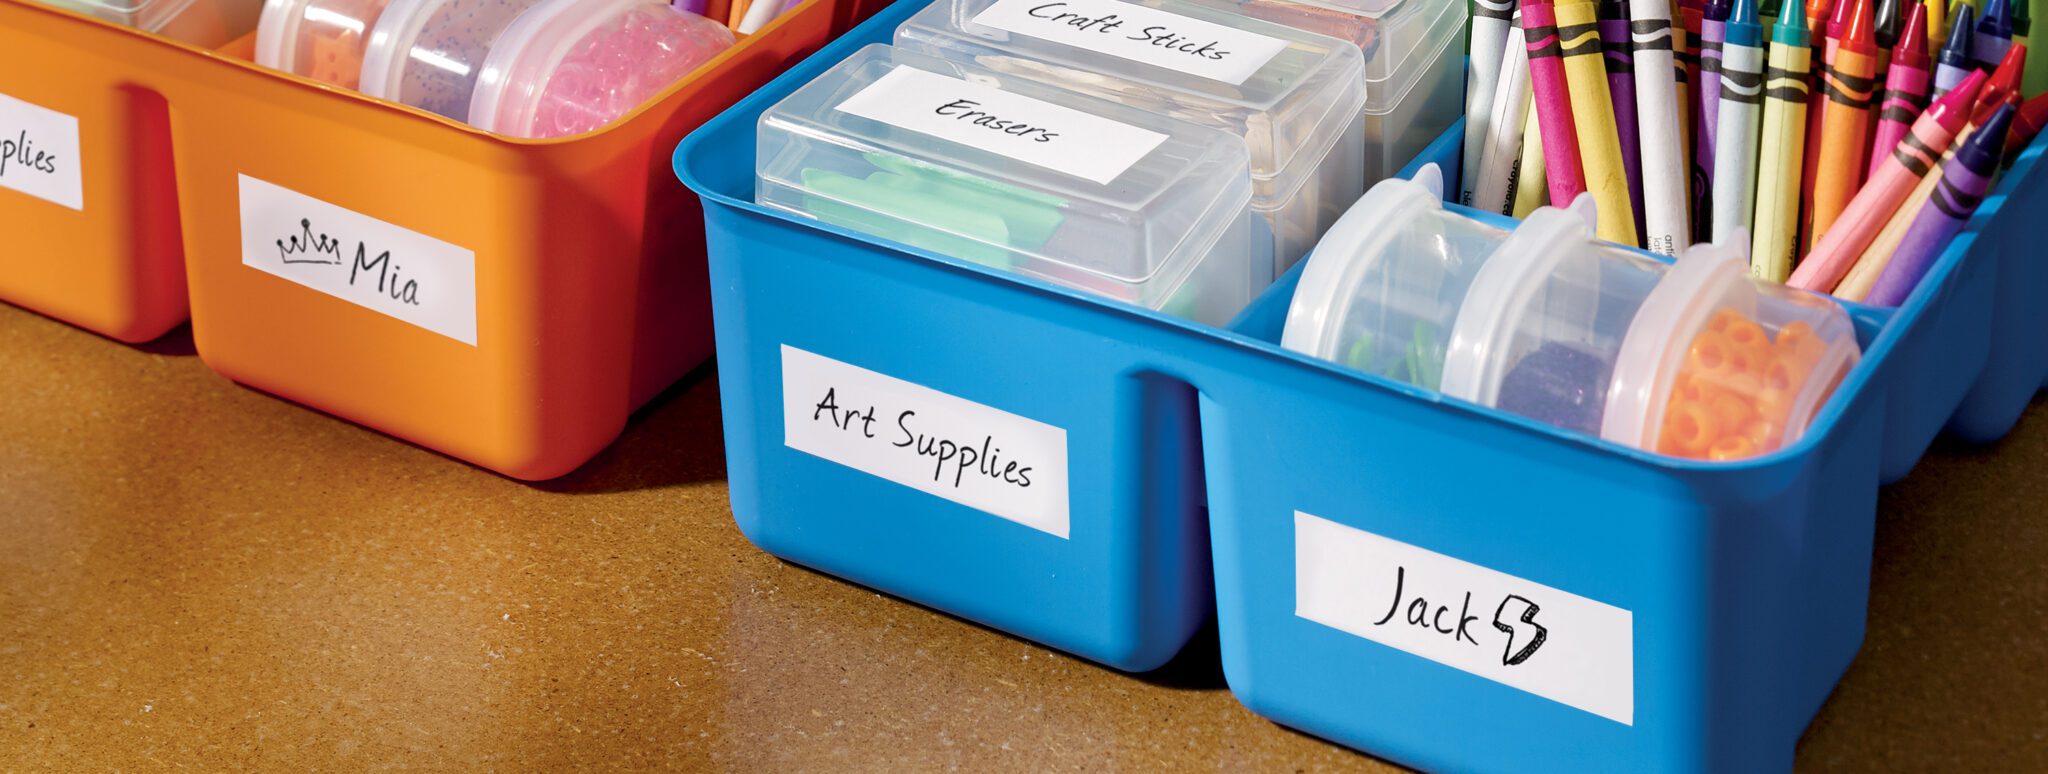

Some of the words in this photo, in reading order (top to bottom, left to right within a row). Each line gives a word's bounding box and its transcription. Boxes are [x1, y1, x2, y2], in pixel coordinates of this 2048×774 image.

[1028, 3, 1123, 33] Craft
[1127, 26, 1230, 60] Sticks
[935, 99, 1059, 142] Erasers
[0, 129, 56, 177] plies
[350, 241, 420, 306] Mia
[814, 387, 877, 438] Art
[893, 410, 1033, 488] Supplies
[1373, 566, 1479, 645] Jack
